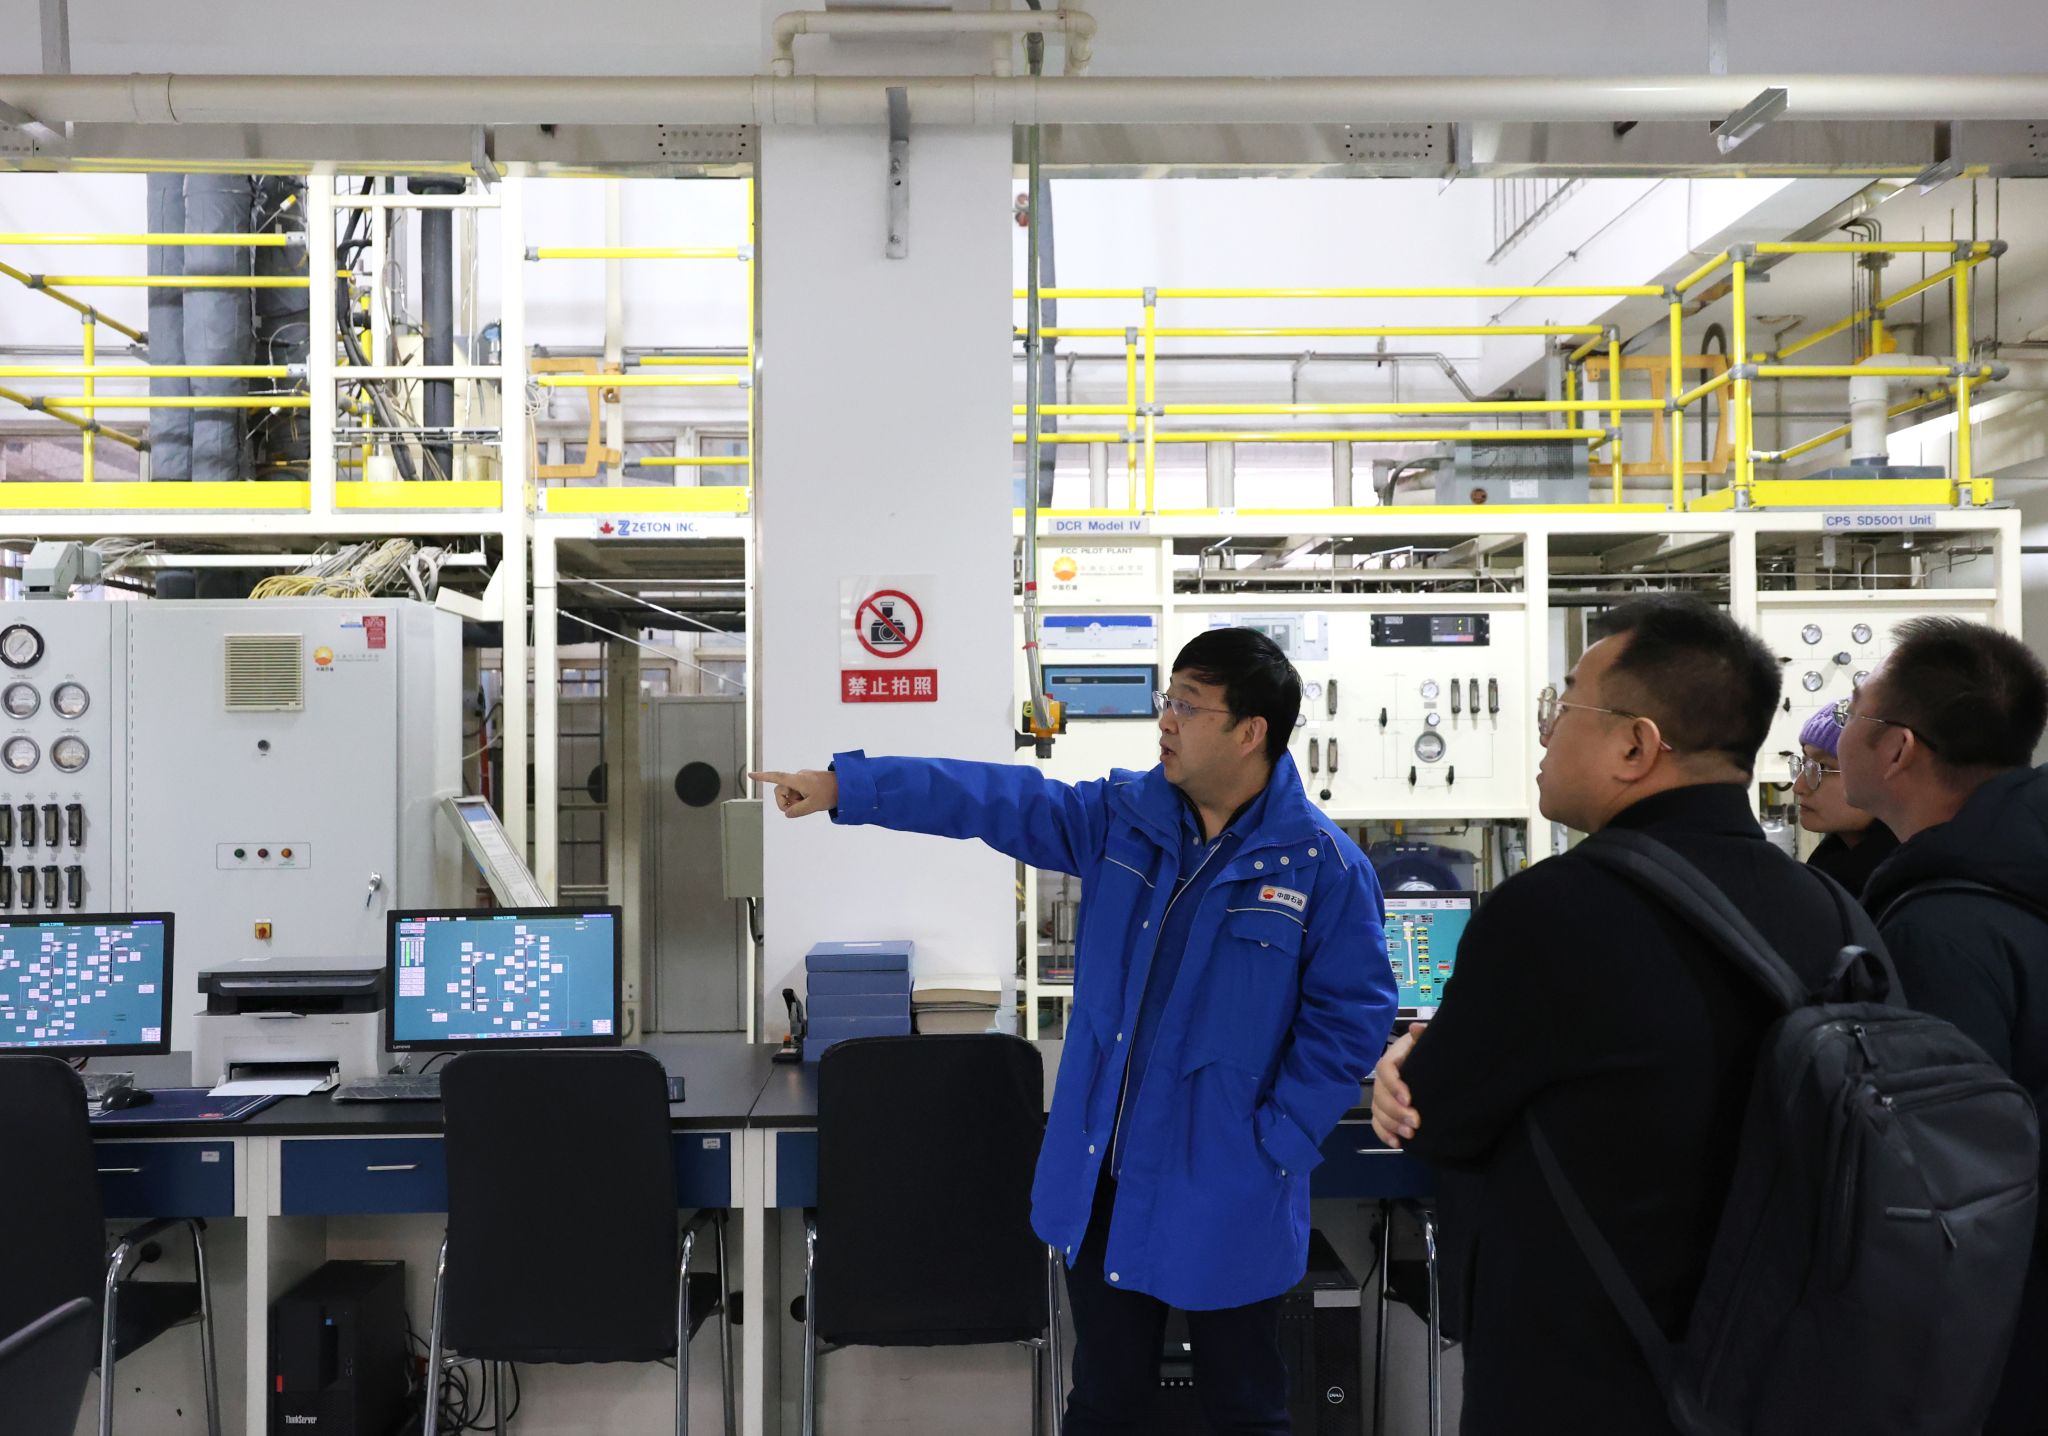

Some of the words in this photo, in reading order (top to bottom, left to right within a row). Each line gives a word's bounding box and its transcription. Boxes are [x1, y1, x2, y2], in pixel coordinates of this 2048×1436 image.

[1056, 520, 1082, 531] DCR
[1088, 520, 1124, 531] Model
[1129, 520, 1141, 530] IV
[1826, 515, 1851, 526] CPS
[1857, 515, 1903, 525] SD5001
[1909, 515, 1932, 525] Unit
[632, 522, 671, 532] ZETON
[676, 522, 698, 532] INC.
[848, 676, 932, 696] 禁止拍照
[1277, 892, 1303, 906] 中国石油
